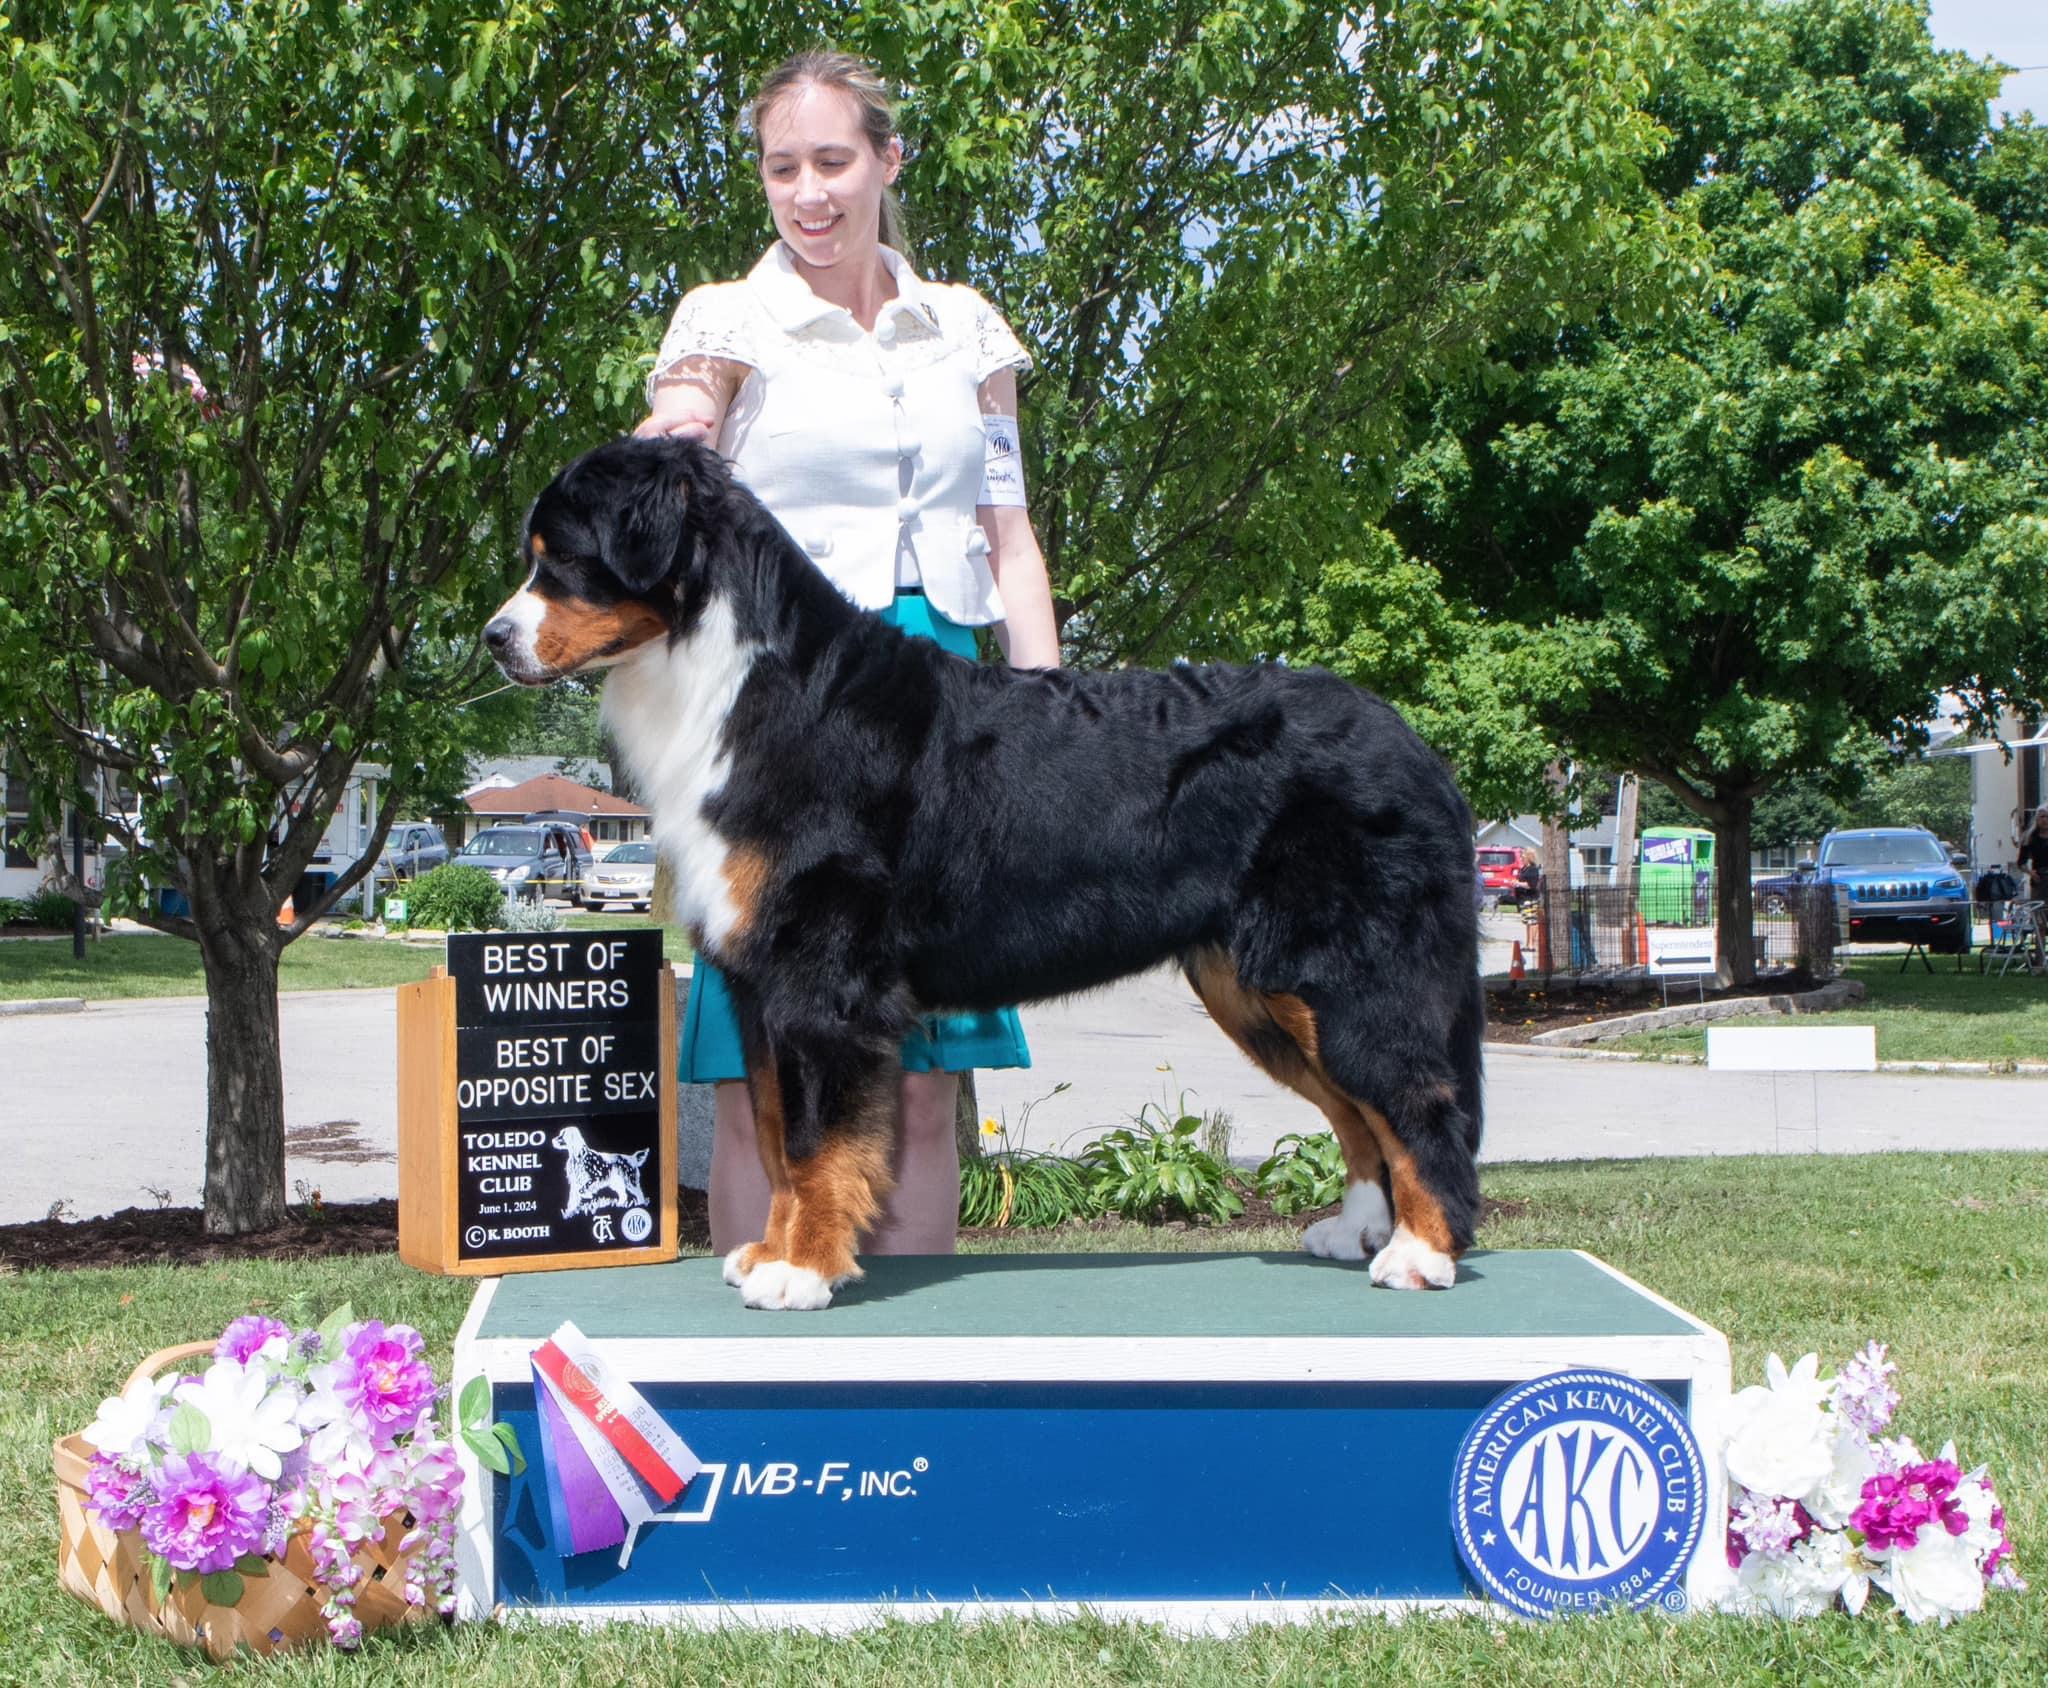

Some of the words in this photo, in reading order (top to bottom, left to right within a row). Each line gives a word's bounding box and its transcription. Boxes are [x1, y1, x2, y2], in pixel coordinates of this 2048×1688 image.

[484, 944, 570, 974] BEST
[587, 942, 627, 970] OF
[483, 980, 628, 1012] WINNERS
[497, 1038, 568, 1068] BEST
[582, 1036, 615, 1063] OF
[457, 1076, 591, 1108] OPPOSITE
[605, 1072, 655, 1100] SEX
[463, 1131, 546, 1149] TOLEDO
[468, 1153, 542, 1172] KENNEL
[480, 1176, 532, 1193] CLUB
[479, 1204, 501, 1214] June
[504, 1203, 512, 1213] 1,
[511, 1201, 537, 1212] 2024
[487, 1229, 501, 1240] K.
[503, 1226, 550, 1239] BOOTH
[1473, 1394, 1558, 1517] AMERICAN
[1566, 1390, 1664, 1444] KENNEL
[1657, 1443, 1688, 1513] CLUB
[1510, 1426, 1650, 1576] AKC
[1504, 1566, 1601, 1607] FOUNDED
[1611, 1566, 1653, 1600] 1884
